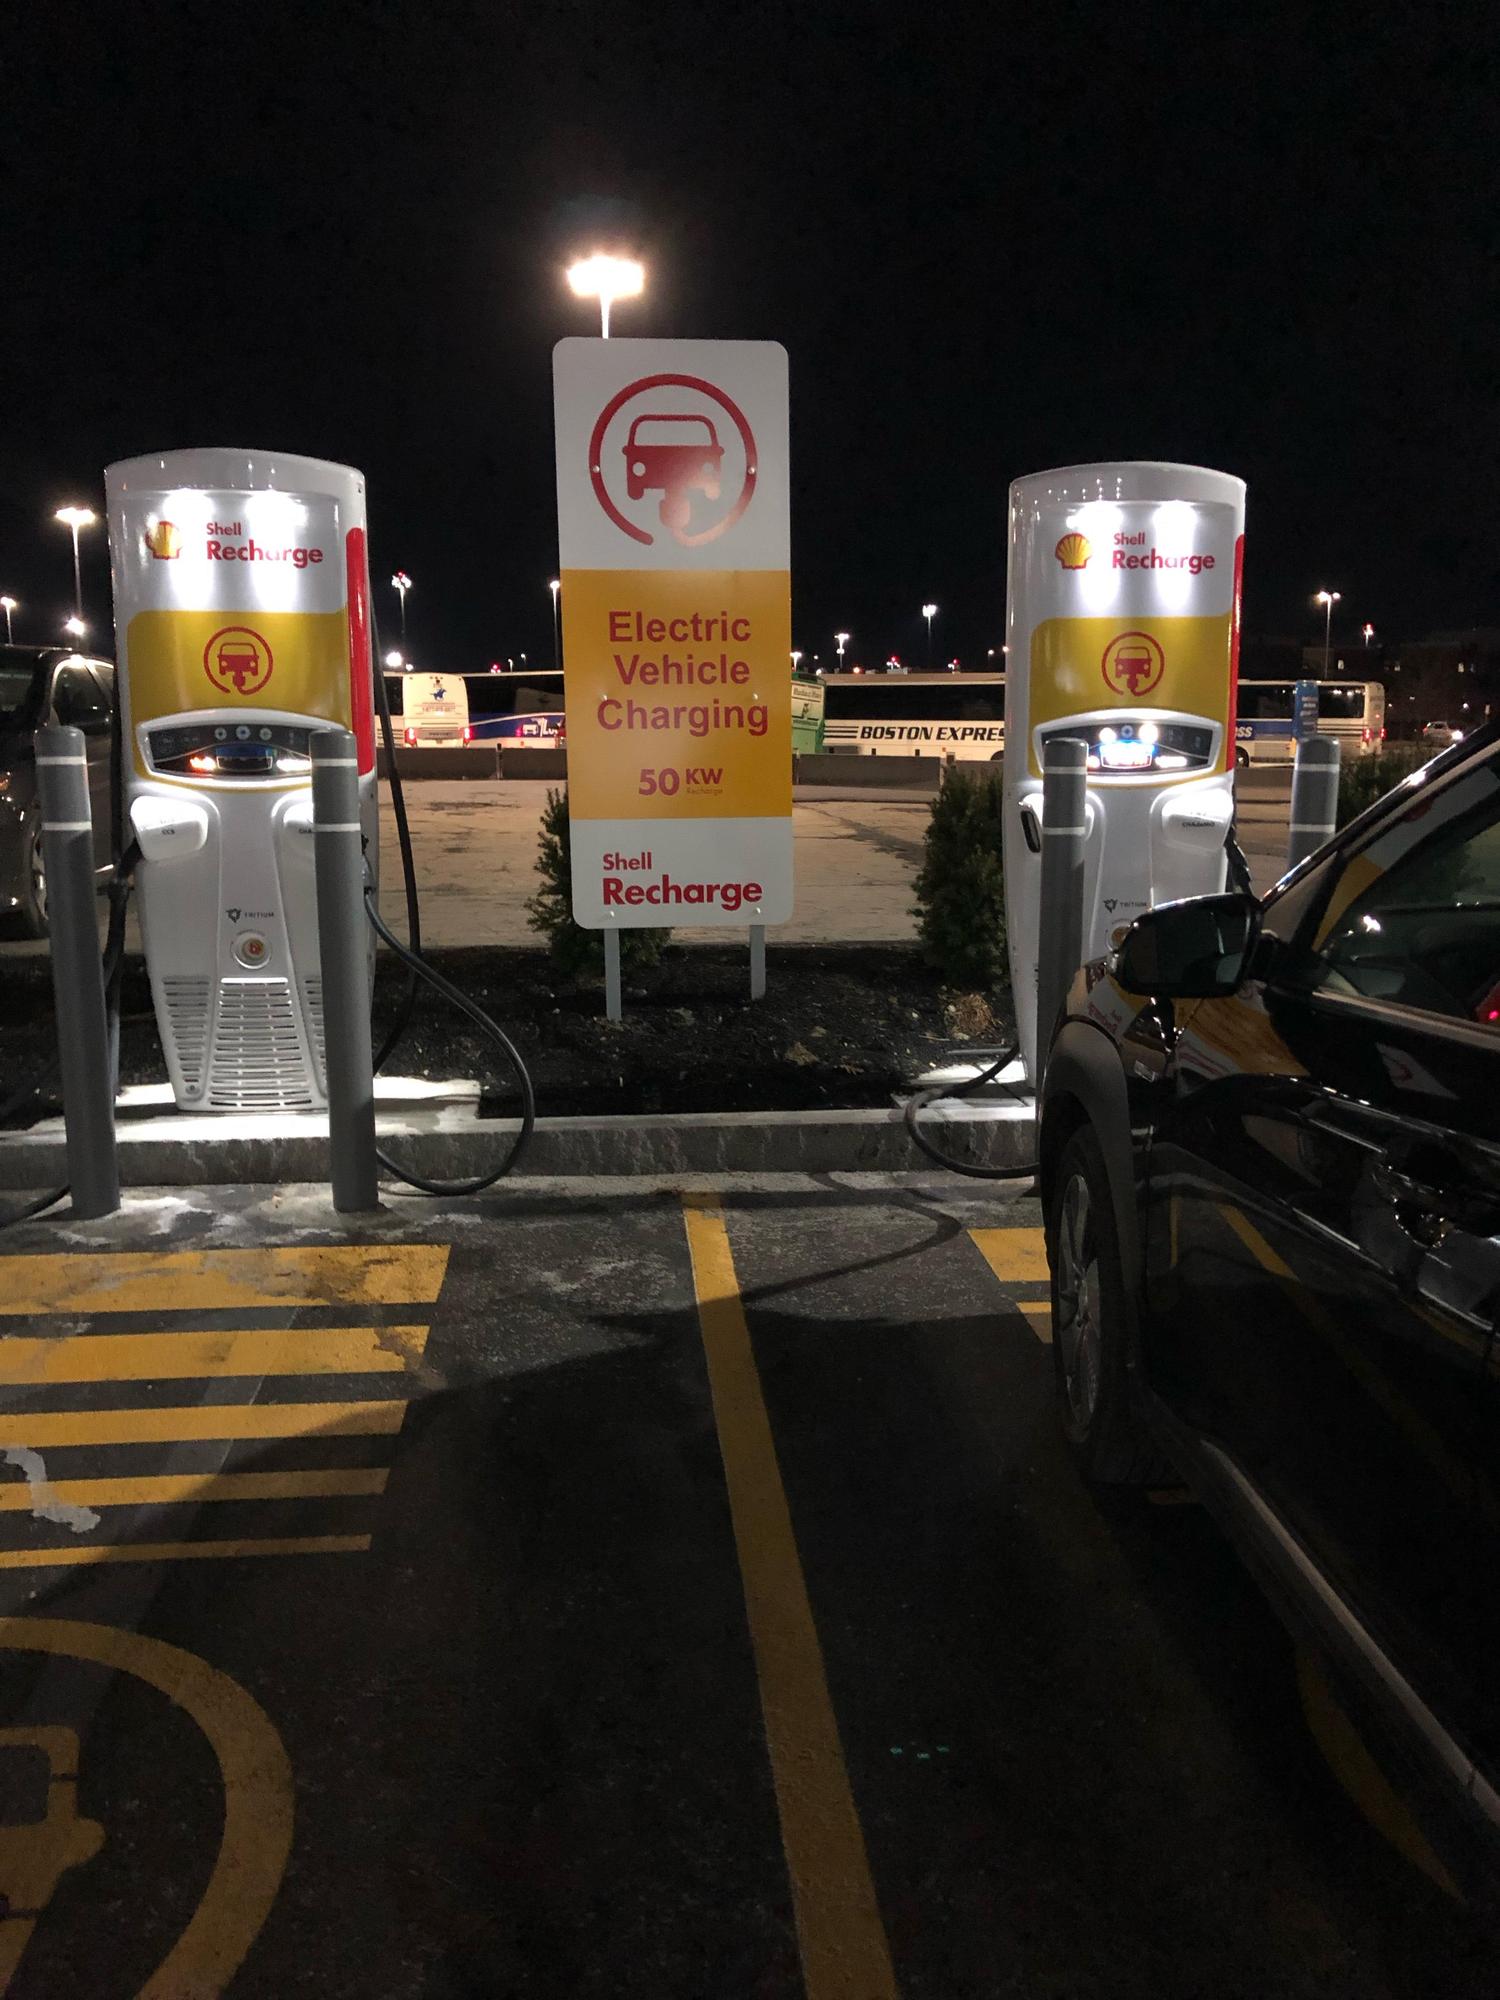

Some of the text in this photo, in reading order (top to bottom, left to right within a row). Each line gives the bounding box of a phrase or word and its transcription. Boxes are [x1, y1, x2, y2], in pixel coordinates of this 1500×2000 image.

[206, 522, 242, 536] Shell
[1113, 532, 1146, 545] Shell
[206, 539, 324, 569] Recharge
[1112, 548, 1216, 575] Recharge
[608, 610, 752, 643] Electric
[613, 653, 751, 686] Vehicle
[597, 698, 769, 738] Charging
[860, 726, 933, 740] BOSTON
[638, 767, 724, 796] 50 KW
[603, 852, 652, 871] Shell
[602, 874, 763, 911] Recharge
